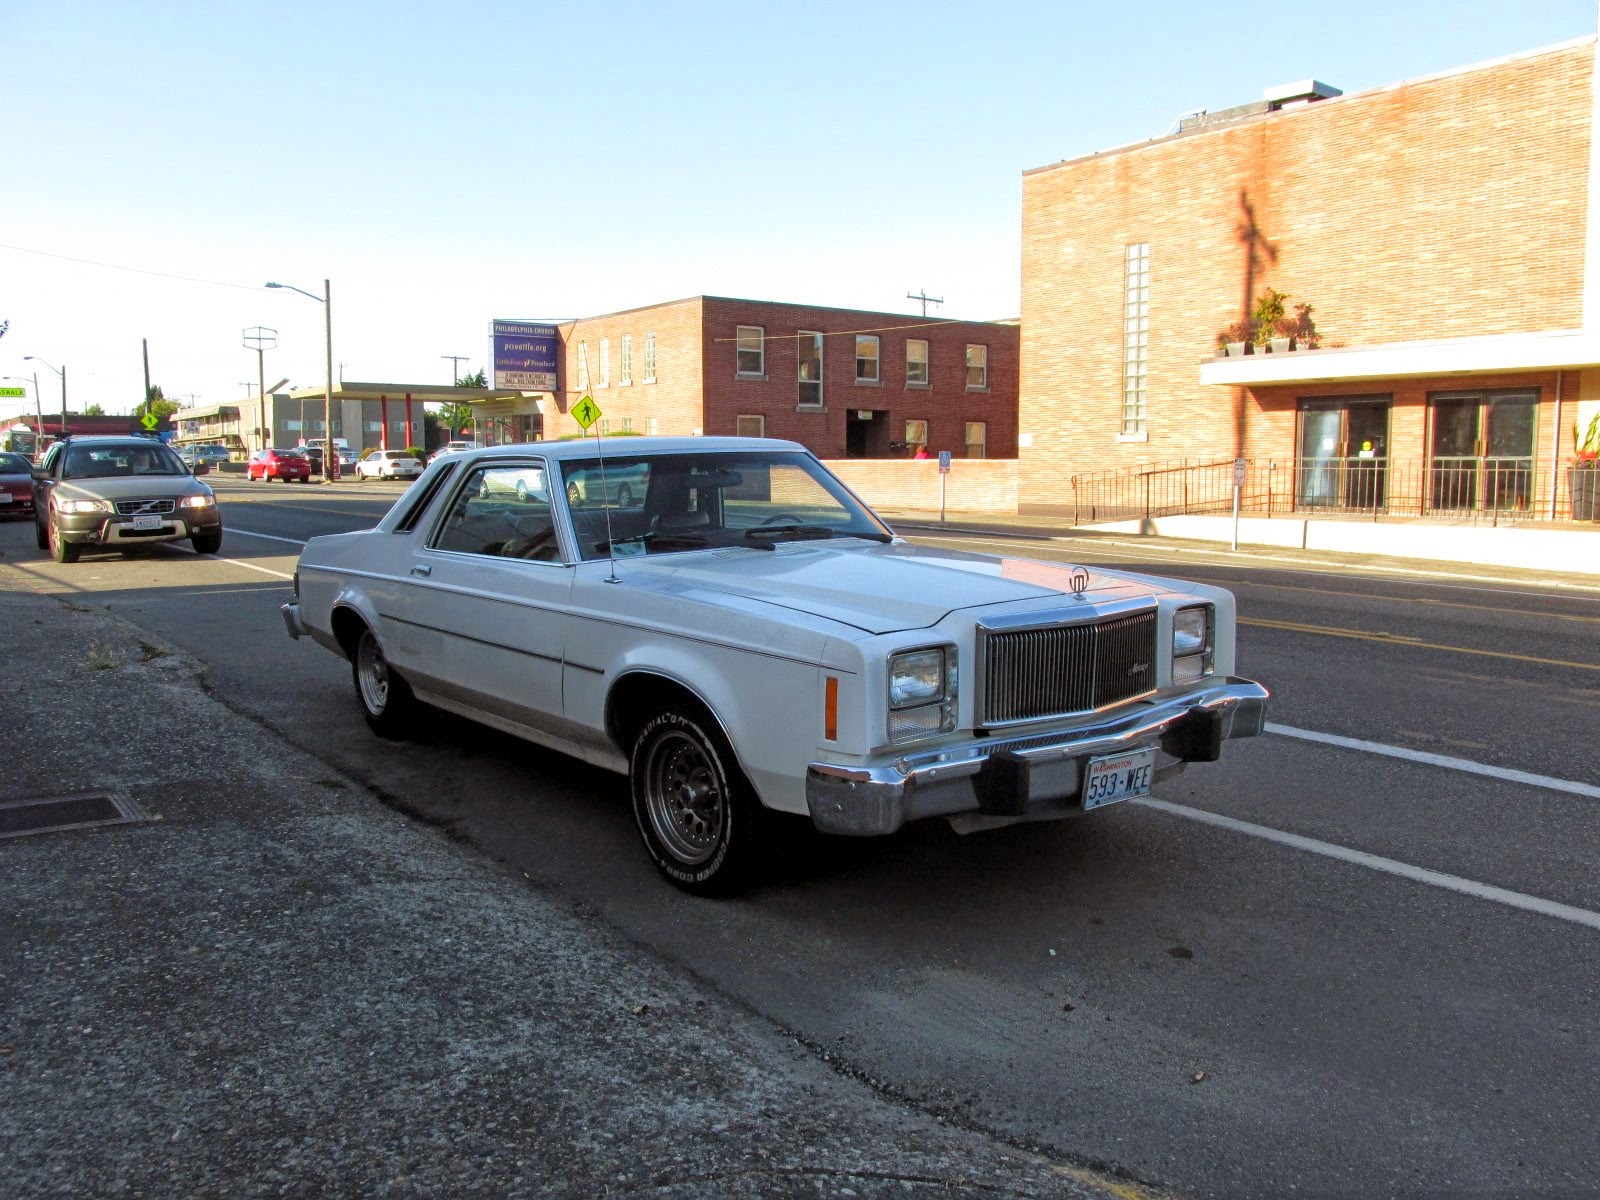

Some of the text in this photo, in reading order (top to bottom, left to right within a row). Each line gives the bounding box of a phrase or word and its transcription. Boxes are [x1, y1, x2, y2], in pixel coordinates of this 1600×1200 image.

[495, 325, 533, 333] PHILADELPHIA
[504, 343, 547, 353] pcseattle.org
[1093, 760, 1133, 774] WASHINGTON
